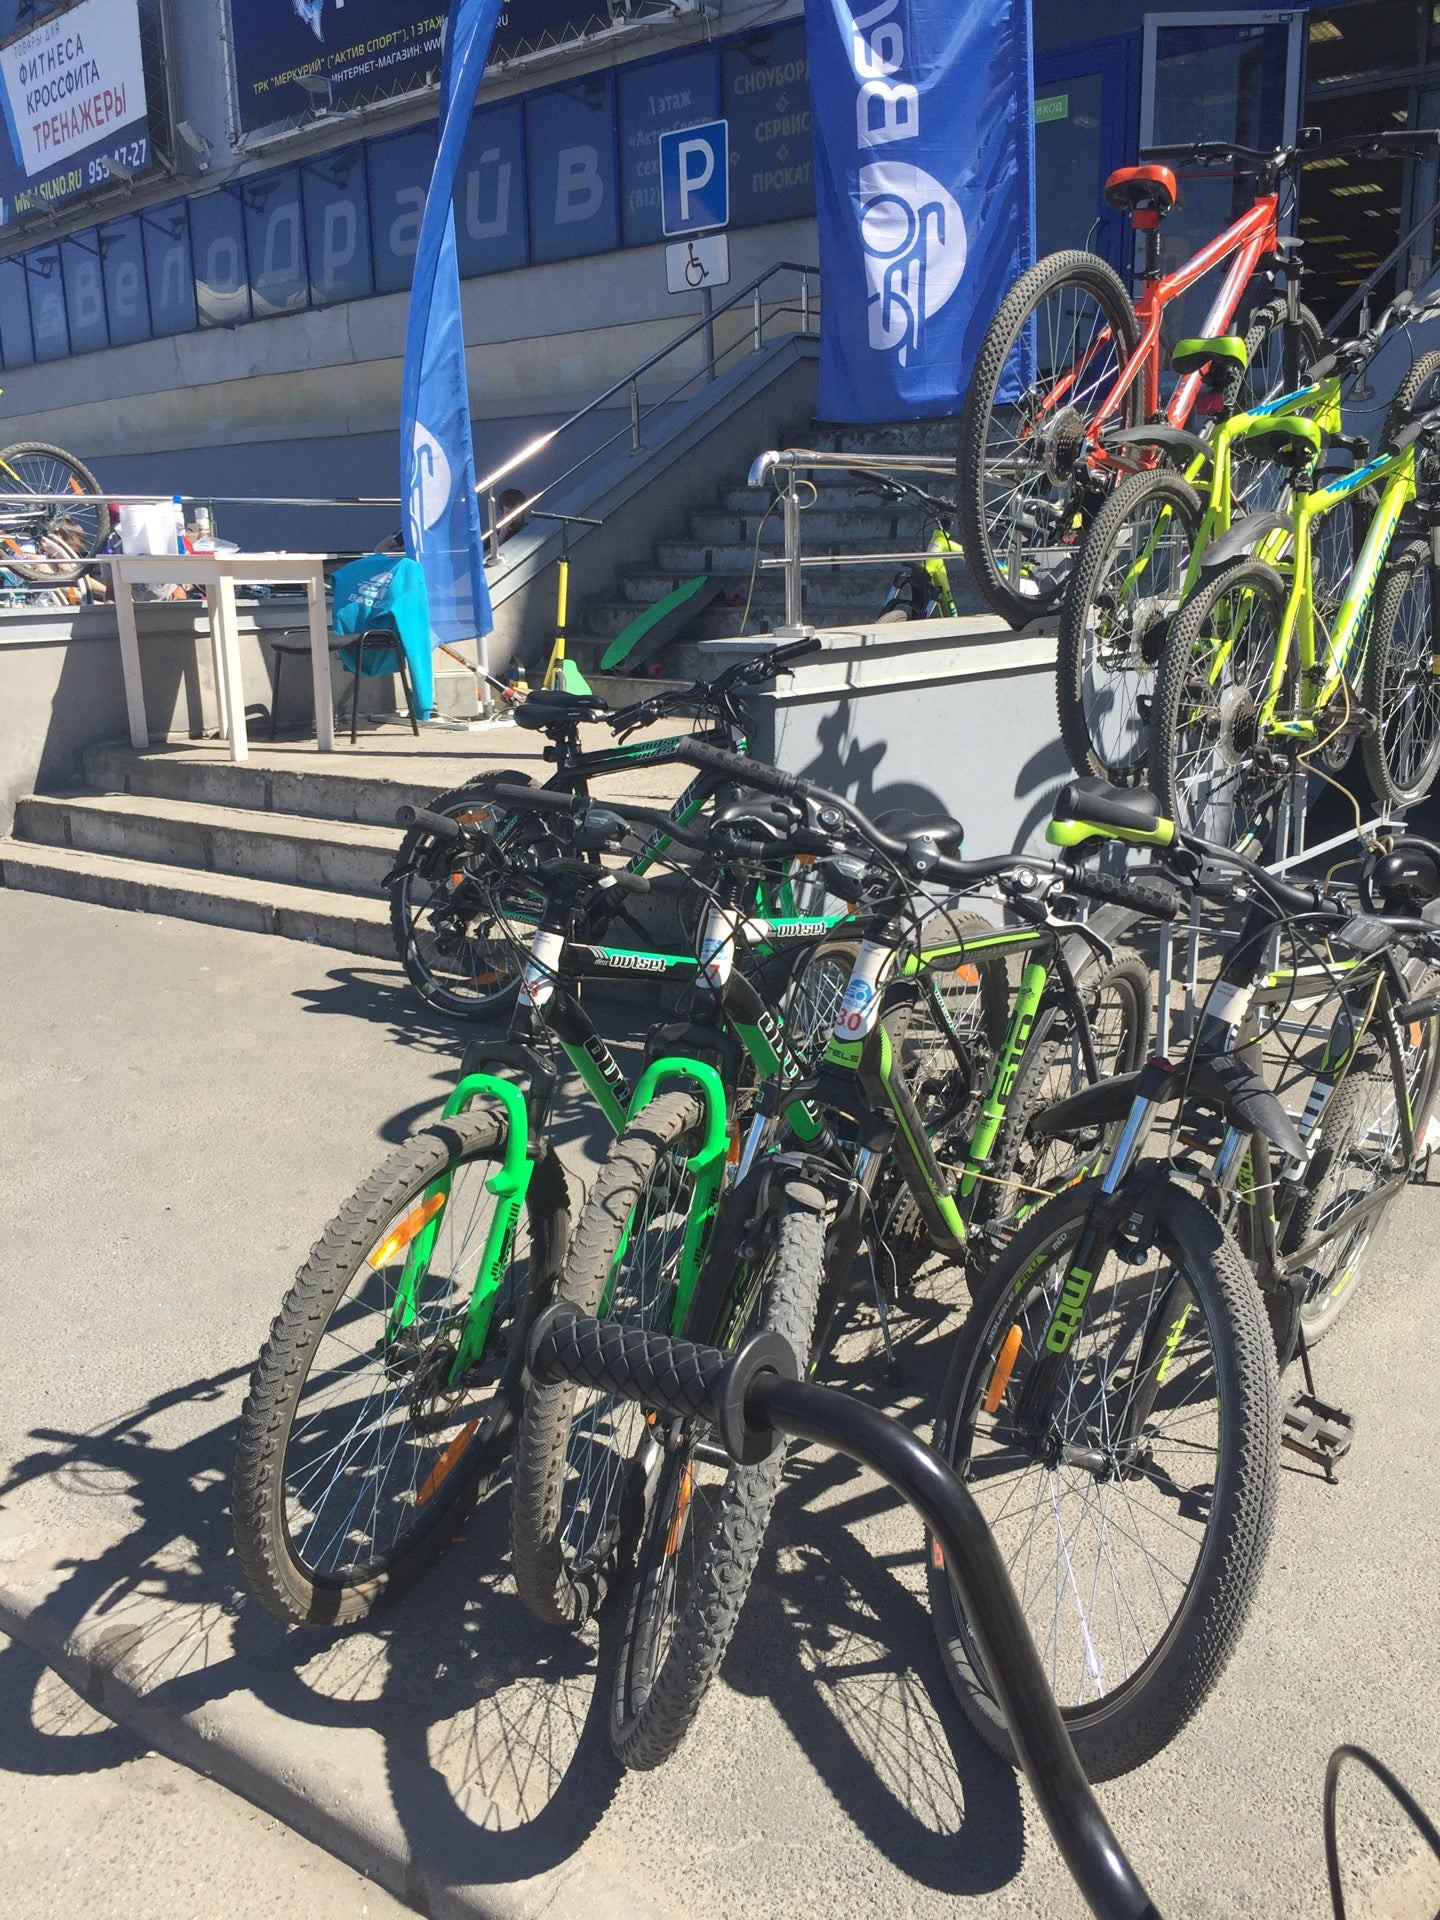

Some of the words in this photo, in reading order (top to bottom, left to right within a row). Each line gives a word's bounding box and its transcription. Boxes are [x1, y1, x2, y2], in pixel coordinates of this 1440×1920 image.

[20, 33, 84, 86] ФИТНЕСА
[734, 58, 810, 94] СНОУБОР
[26, 59, 100, 115] КРОССФИТА
[253, 80, 269, 94] ТРК
[33, 82, 126, 153] ТРЕНАЖЕРЫ
[755, 110, 810, 141] СЕРВИС
[1036, 102, 1063, 116] ВХОД
[679, 138, 714, 220] P
[753, 162, 812, 192] ПРОКАТ
[836, 1007, 862, 1032] 30
